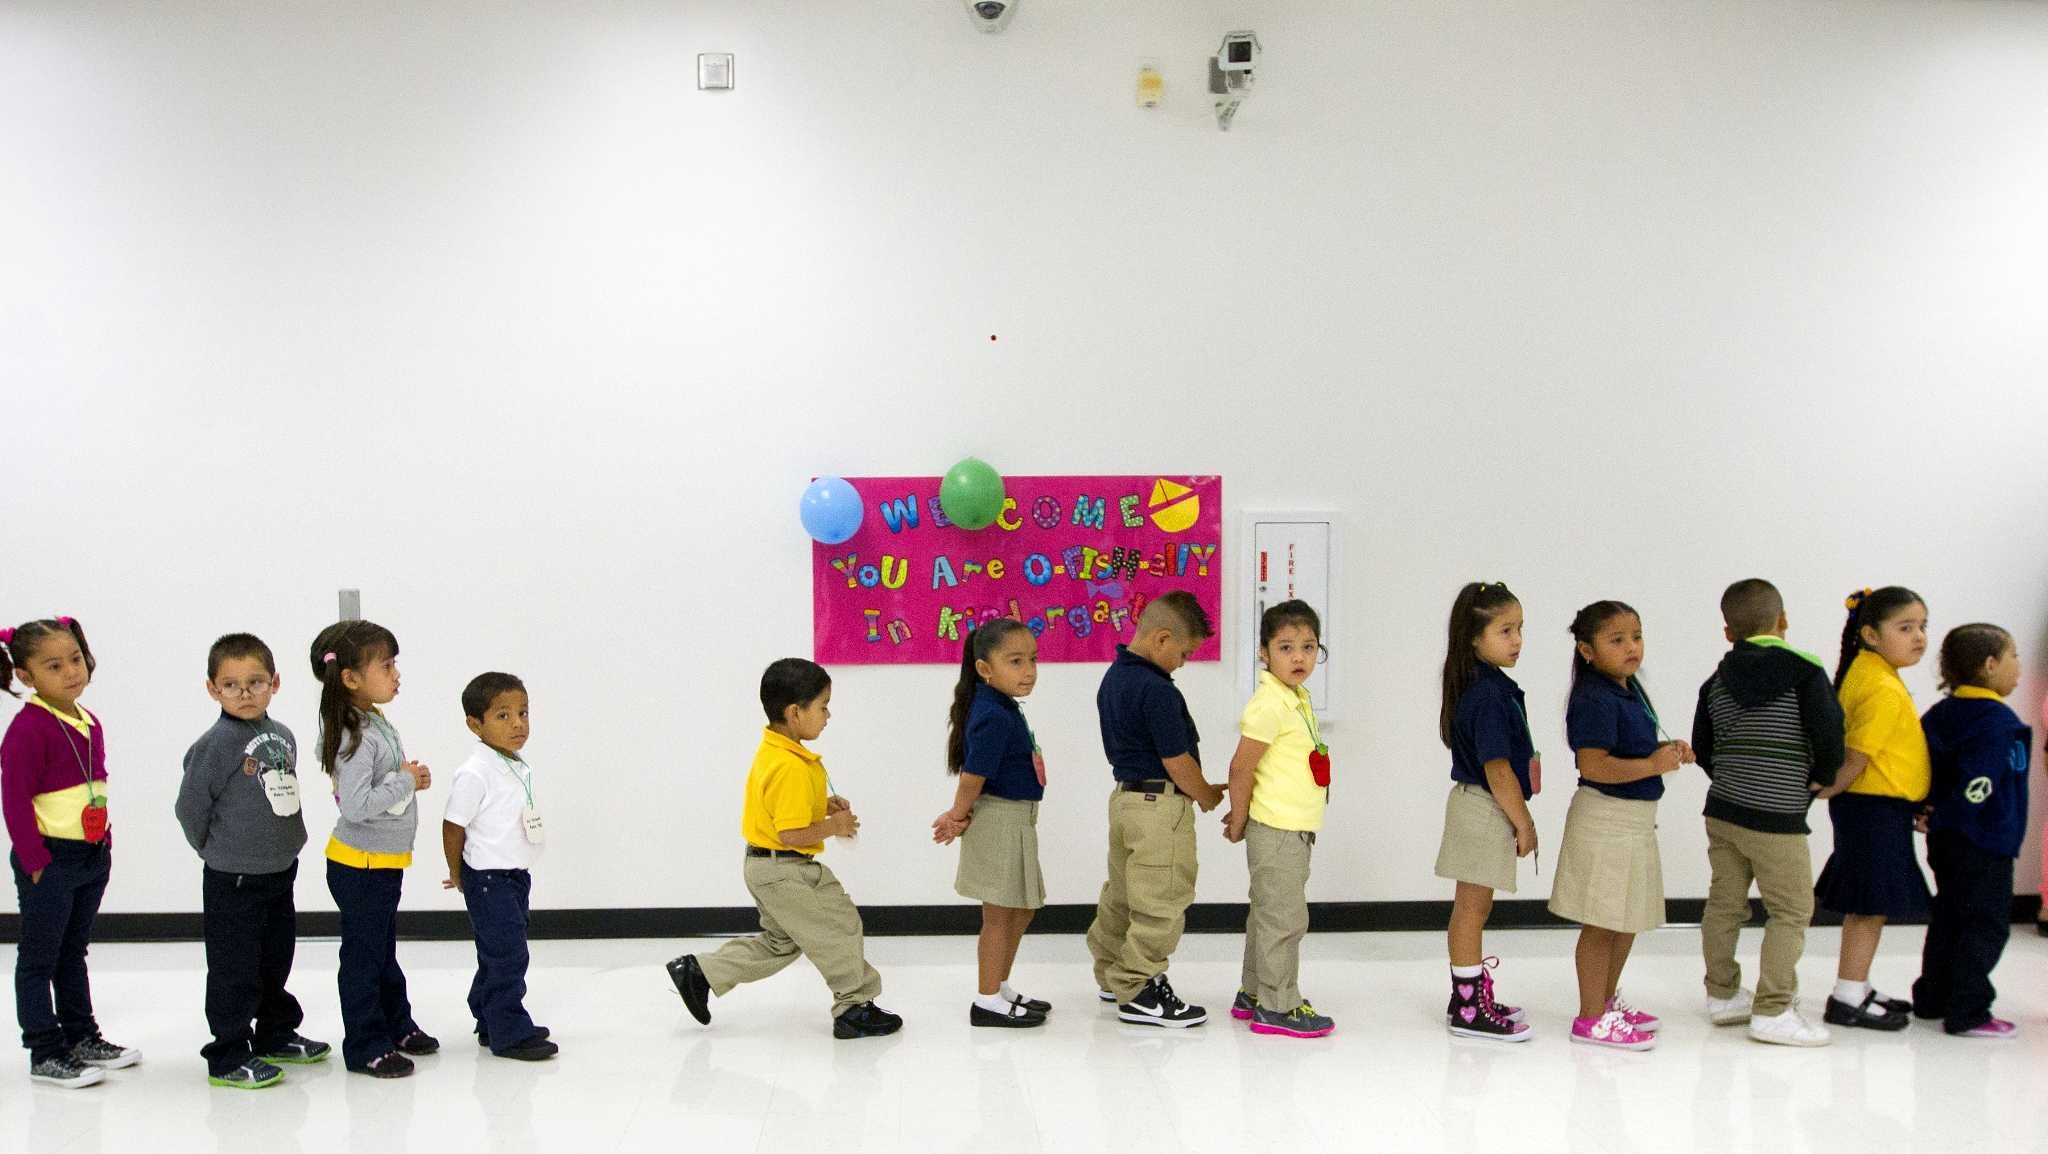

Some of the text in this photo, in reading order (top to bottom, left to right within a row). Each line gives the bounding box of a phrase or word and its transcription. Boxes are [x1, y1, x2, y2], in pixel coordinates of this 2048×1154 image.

[880, 493, 1144, 534] WECOME
[932, 554, 1006, 592] Are
[863, 608, 913, 645] In
